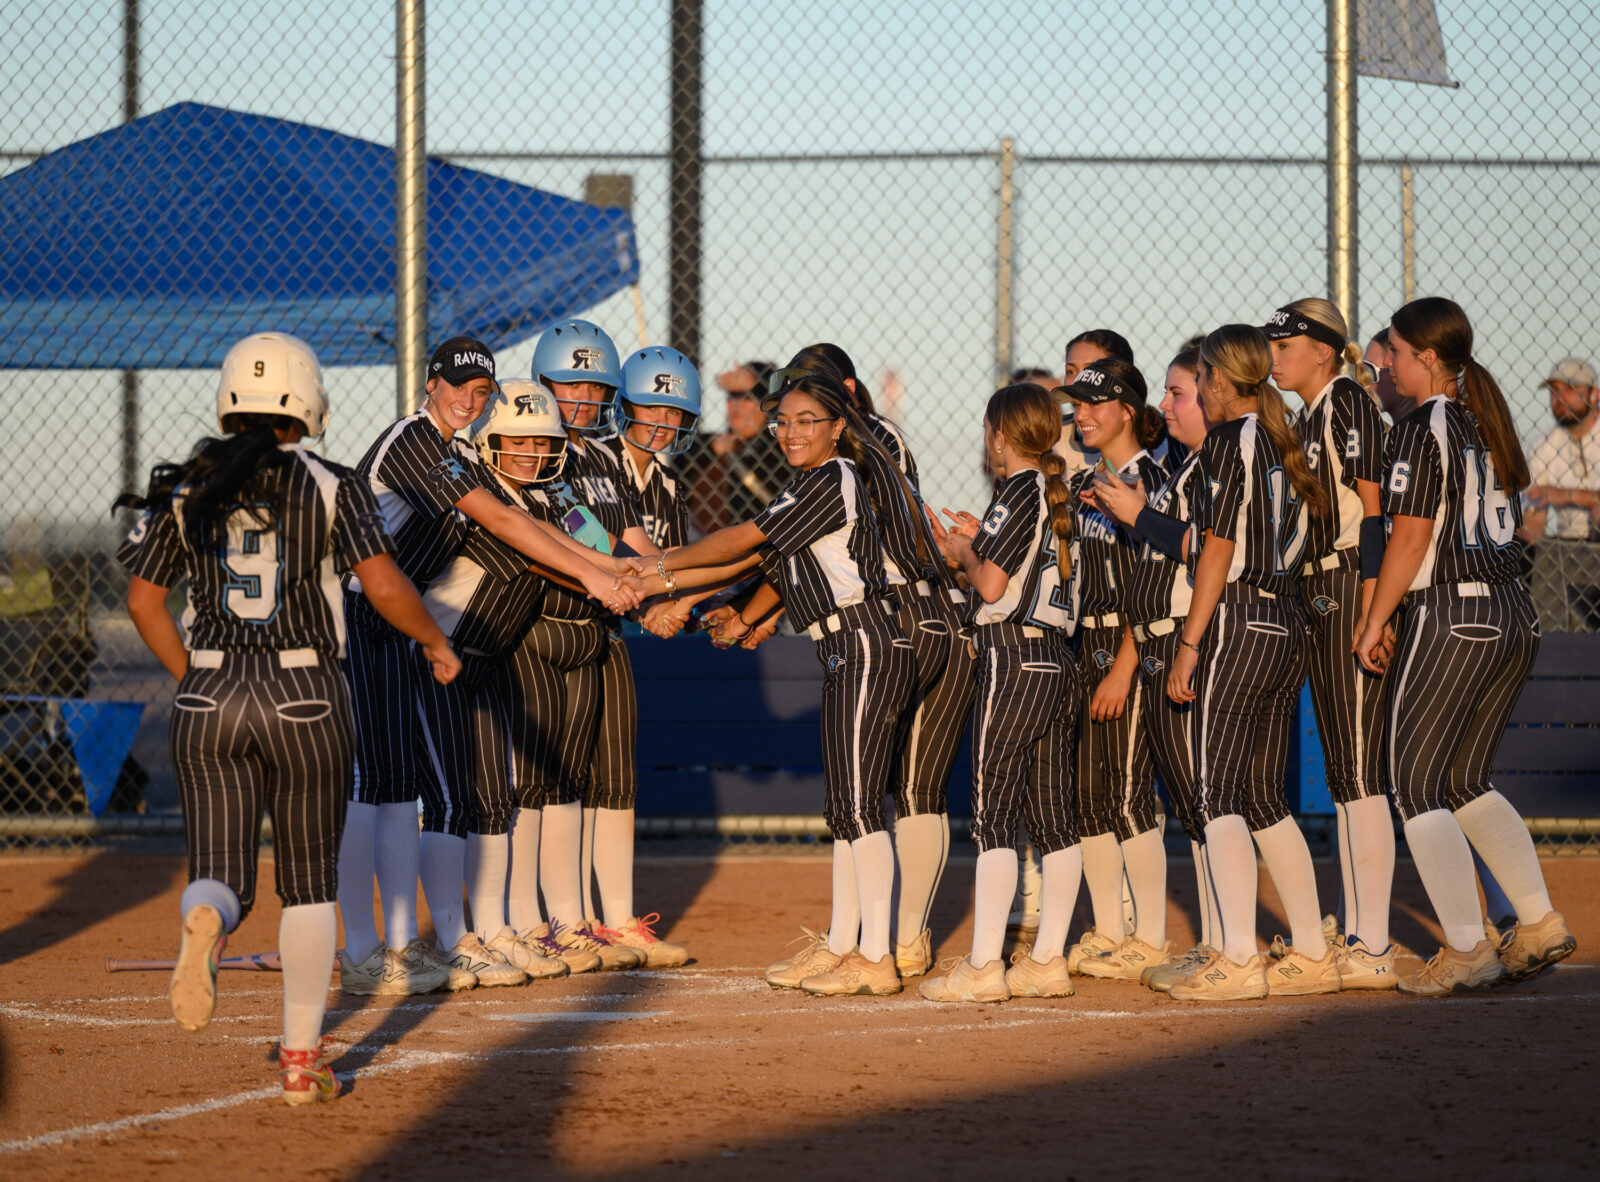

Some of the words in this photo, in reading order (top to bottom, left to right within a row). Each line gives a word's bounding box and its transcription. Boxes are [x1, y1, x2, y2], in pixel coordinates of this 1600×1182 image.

[254, 360, 265, 377] 9
[454, 351, 494, 375] RAVENS
[1388, 460, 1413, 494] 6
[767, 490, 798, 517] 7
[982, 503, 1011, 537] 3
[221, 503, 284, 625] 9
[1104, 557, 1118, 591] 1
